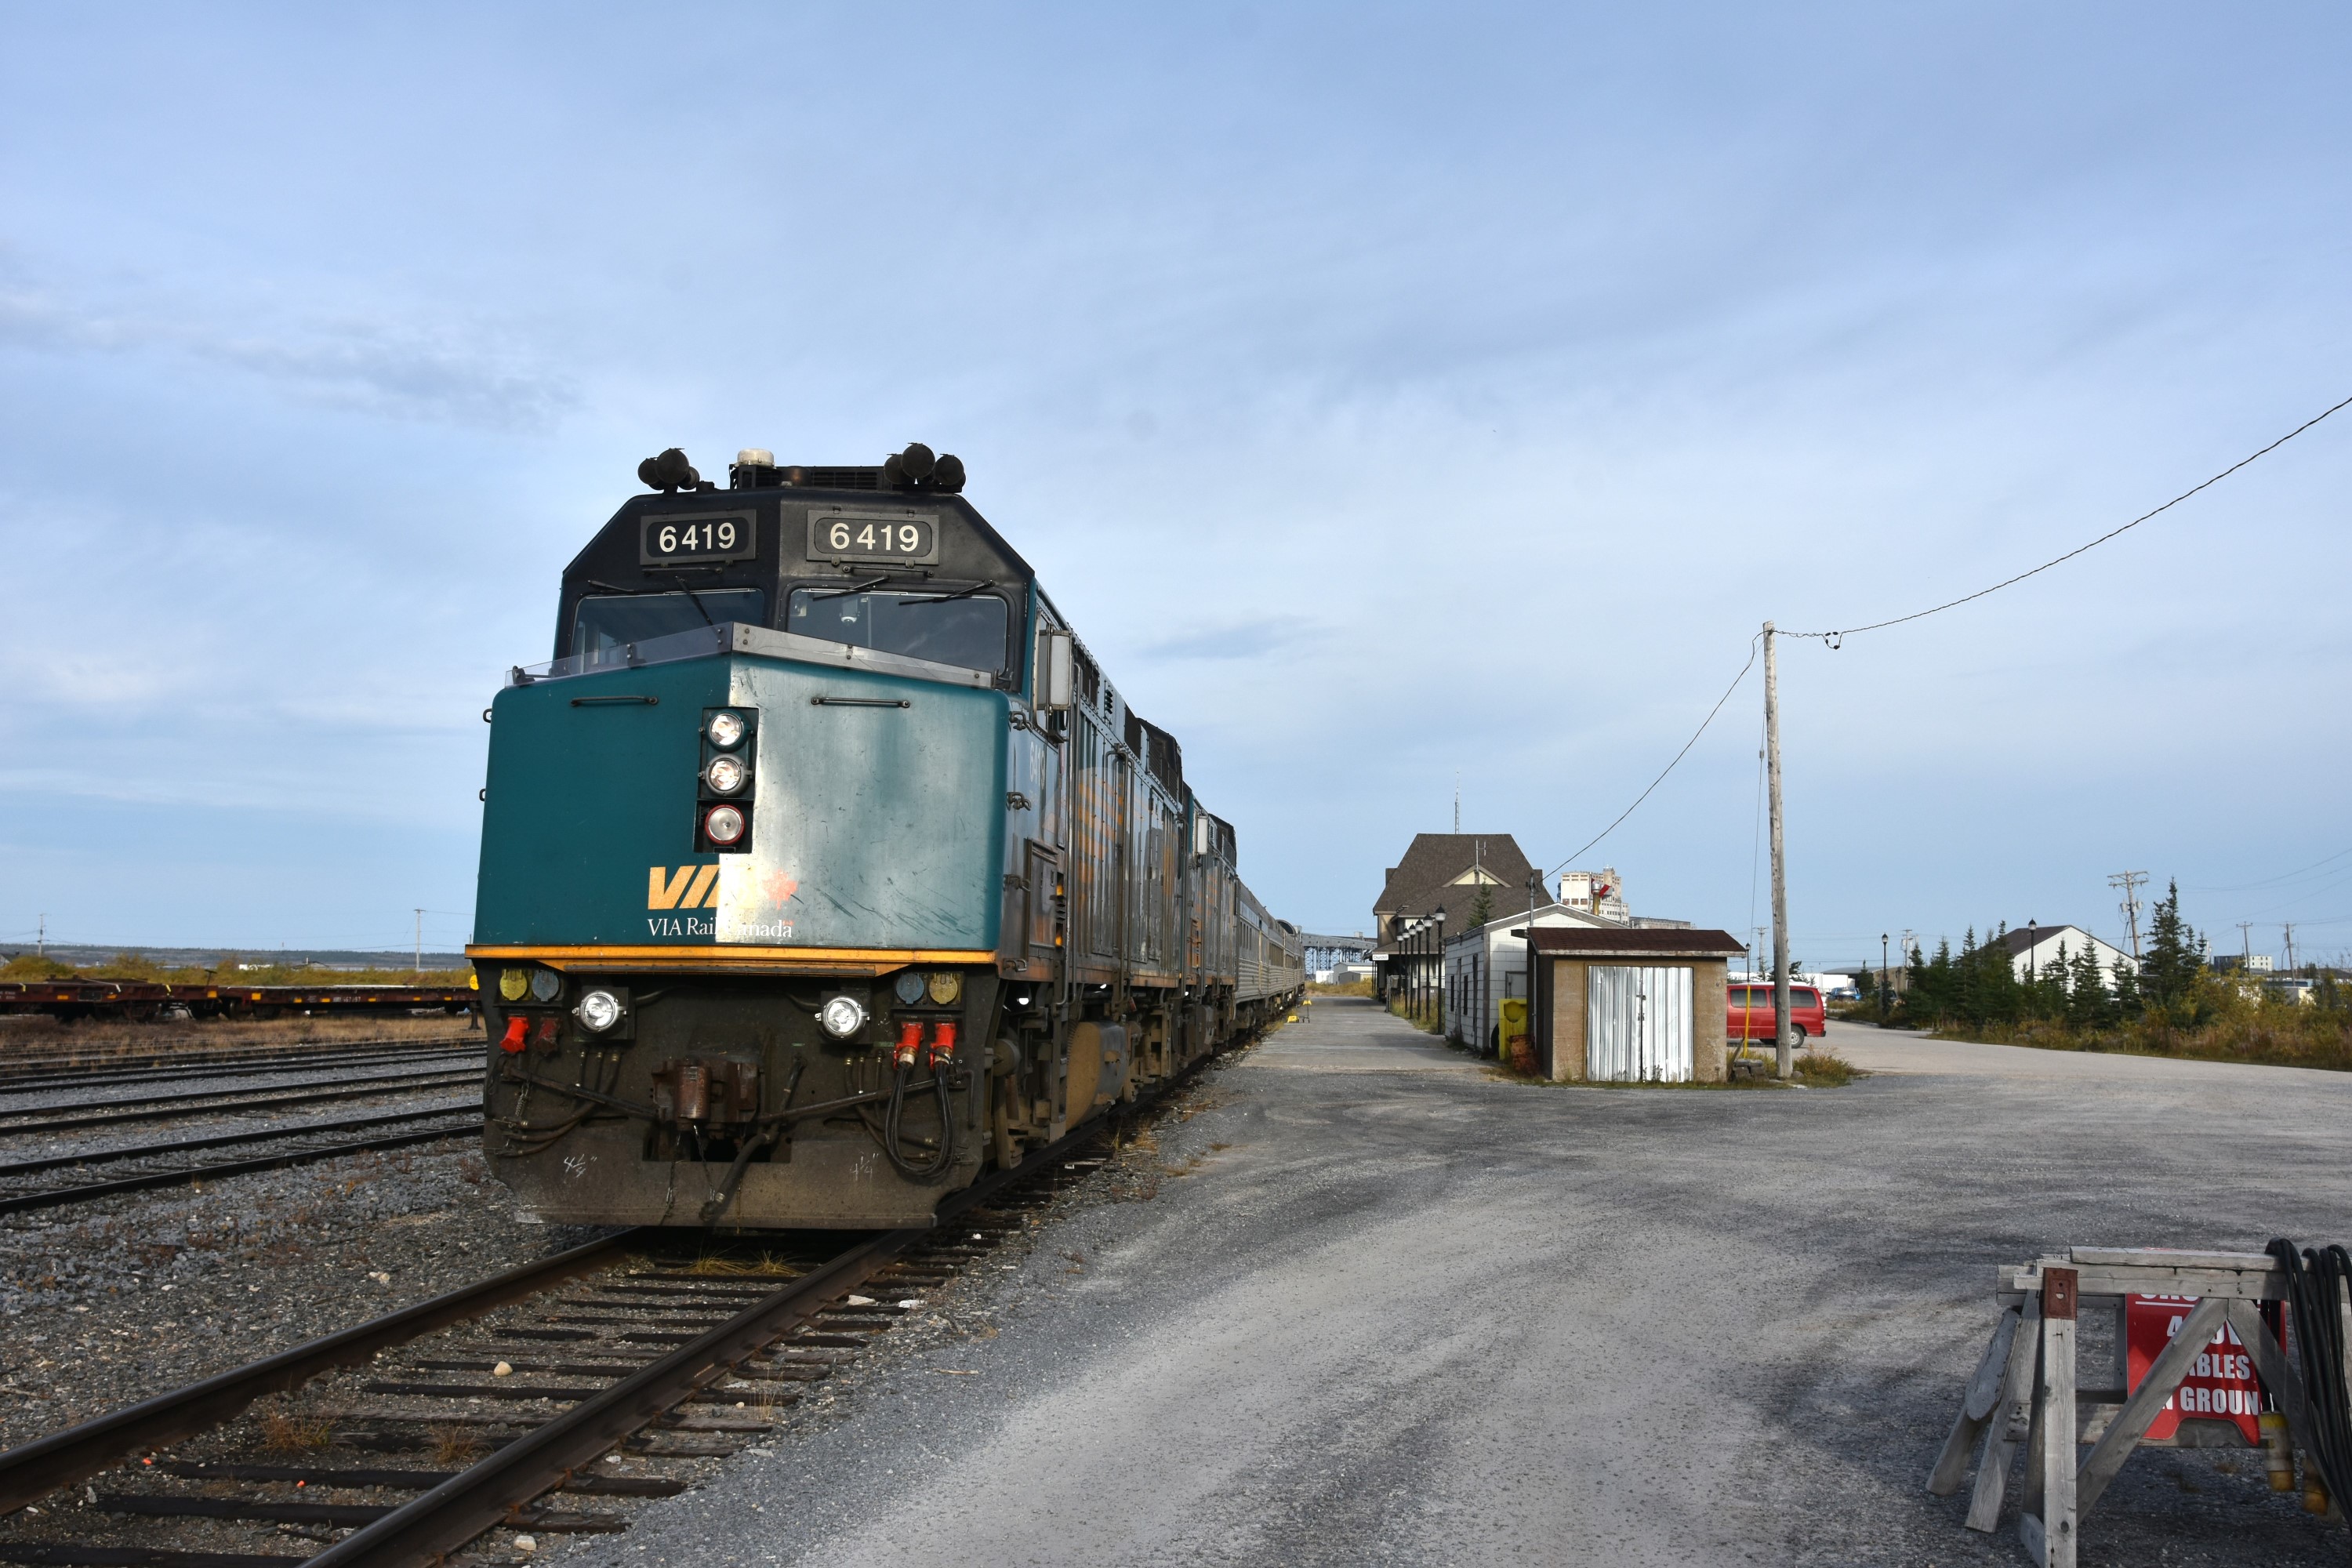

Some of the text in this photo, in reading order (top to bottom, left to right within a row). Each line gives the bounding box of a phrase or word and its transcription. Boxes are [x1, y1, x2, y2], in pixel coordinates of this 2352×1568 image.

[659, 522, 736, 553] 6419
[829, 522, 920, 552] 6419
[1029, 741, 1046, 790] 6419
[648, 918, 683, 937] VIA
[2188, 1352, 2251, 1380] BLES
[2180, 1386, 2263, 1416] GROUN
